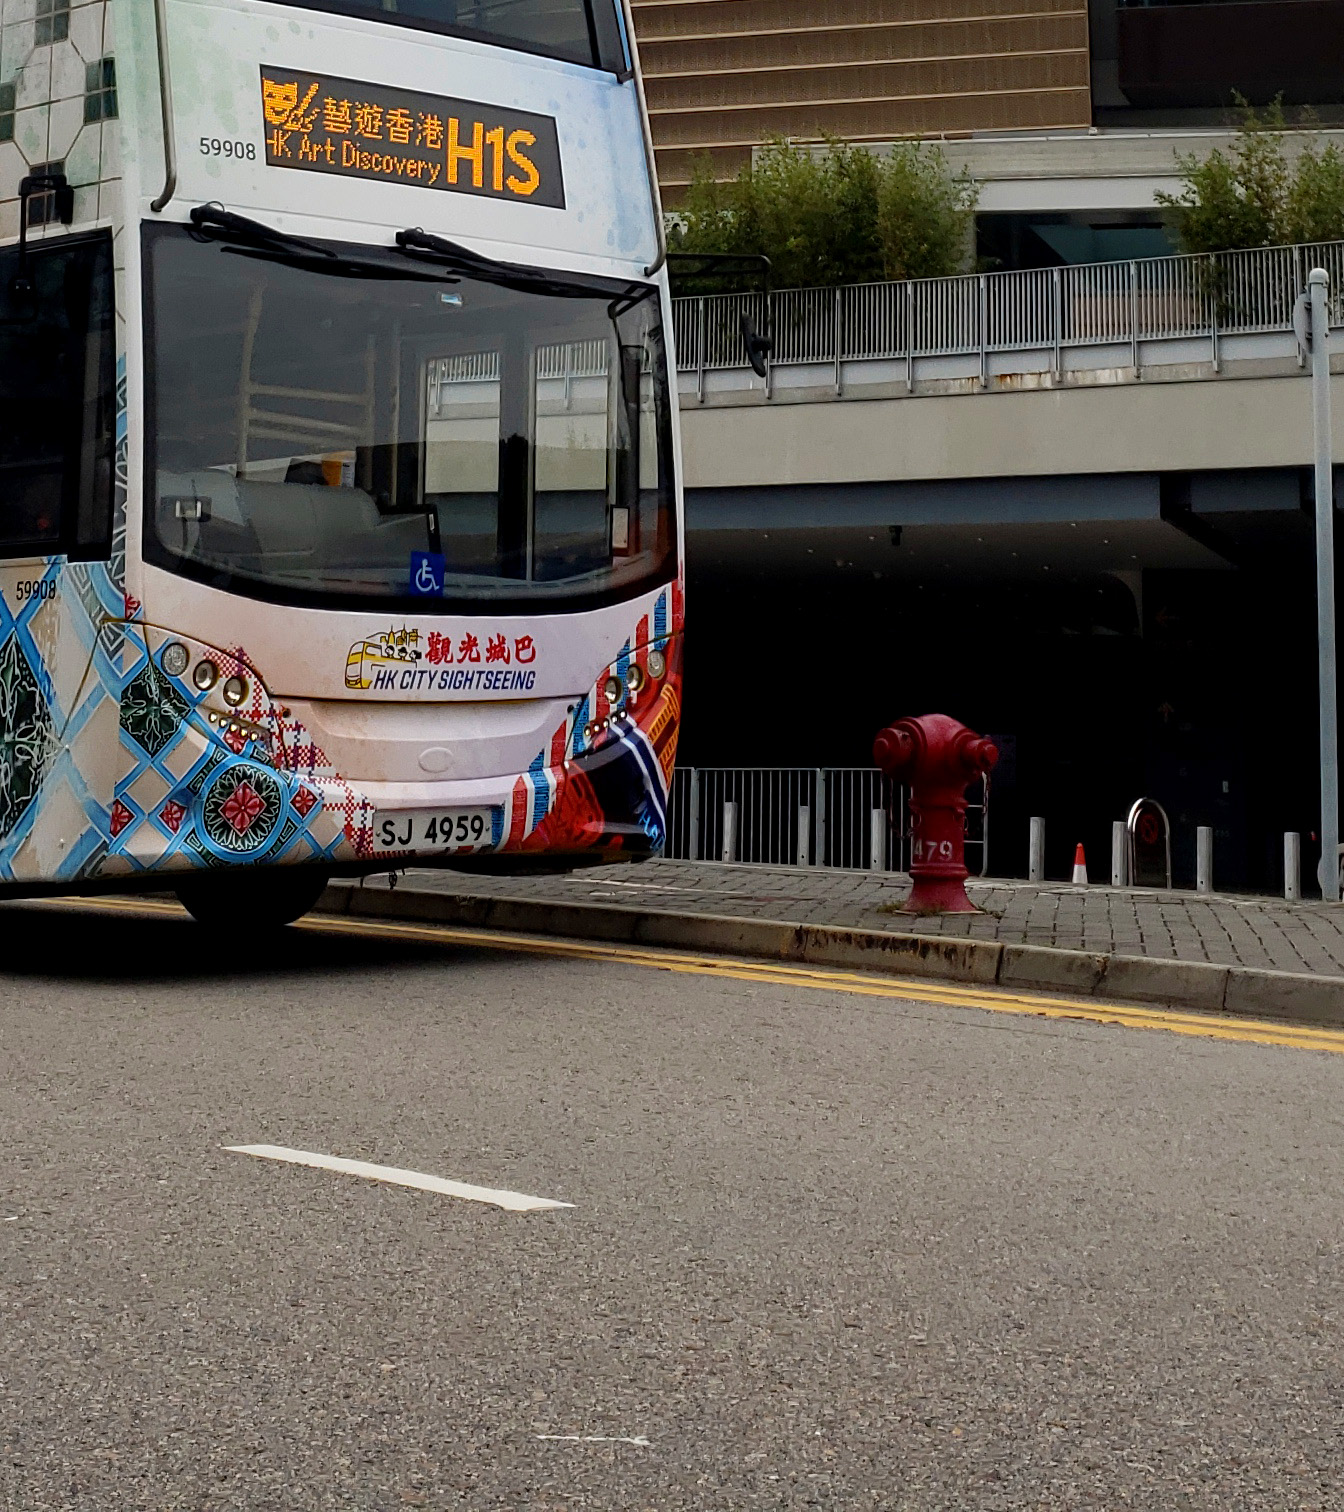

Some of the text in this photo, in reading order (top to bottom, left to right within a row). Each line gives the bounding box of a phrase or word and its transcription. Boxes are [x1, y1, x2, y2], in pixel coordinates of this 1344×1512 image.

[322, 96, 445, 150] 藝遊香港
[199, 137, 256, 161] 59908
[298, 134, 336, 165] Art
[341, 139, 442, 186] Discovery
[446, 117, 540, 196] H1S
[16, 579, 57, 601] 59908
[425, 631, 537, 665] 觀光城巴
[373, 670, 537, 690] HK CITY SIGHTSEEING
[381, 815, 485, 846] SJ 4959
[914, 840, 954, 862] 479
